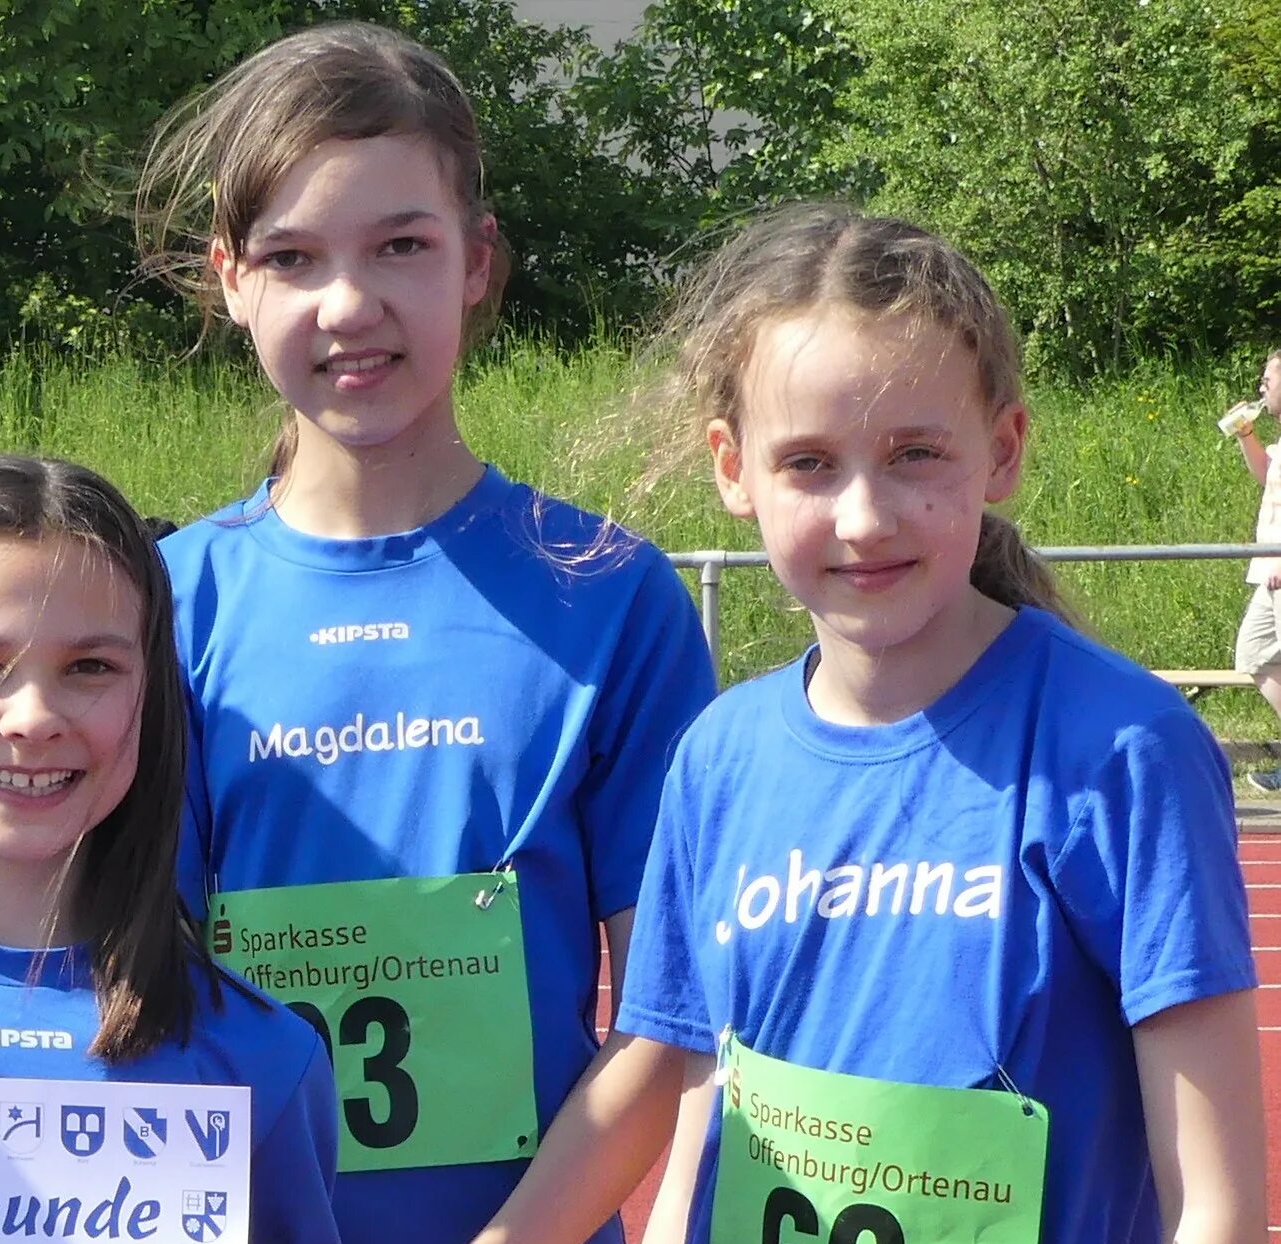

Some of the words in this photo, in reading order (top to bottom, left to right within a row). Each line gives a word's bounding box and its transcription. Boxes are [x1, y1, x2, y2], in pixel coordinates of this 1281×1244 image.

[249, 712, 484, 765] Magdalena
[240, 923, 368, 957] Sparkasse
[750, 1093, 872, 1146] Sparkasse
[748, 1134, 1011, 1204] Offenburg/Ortenau
